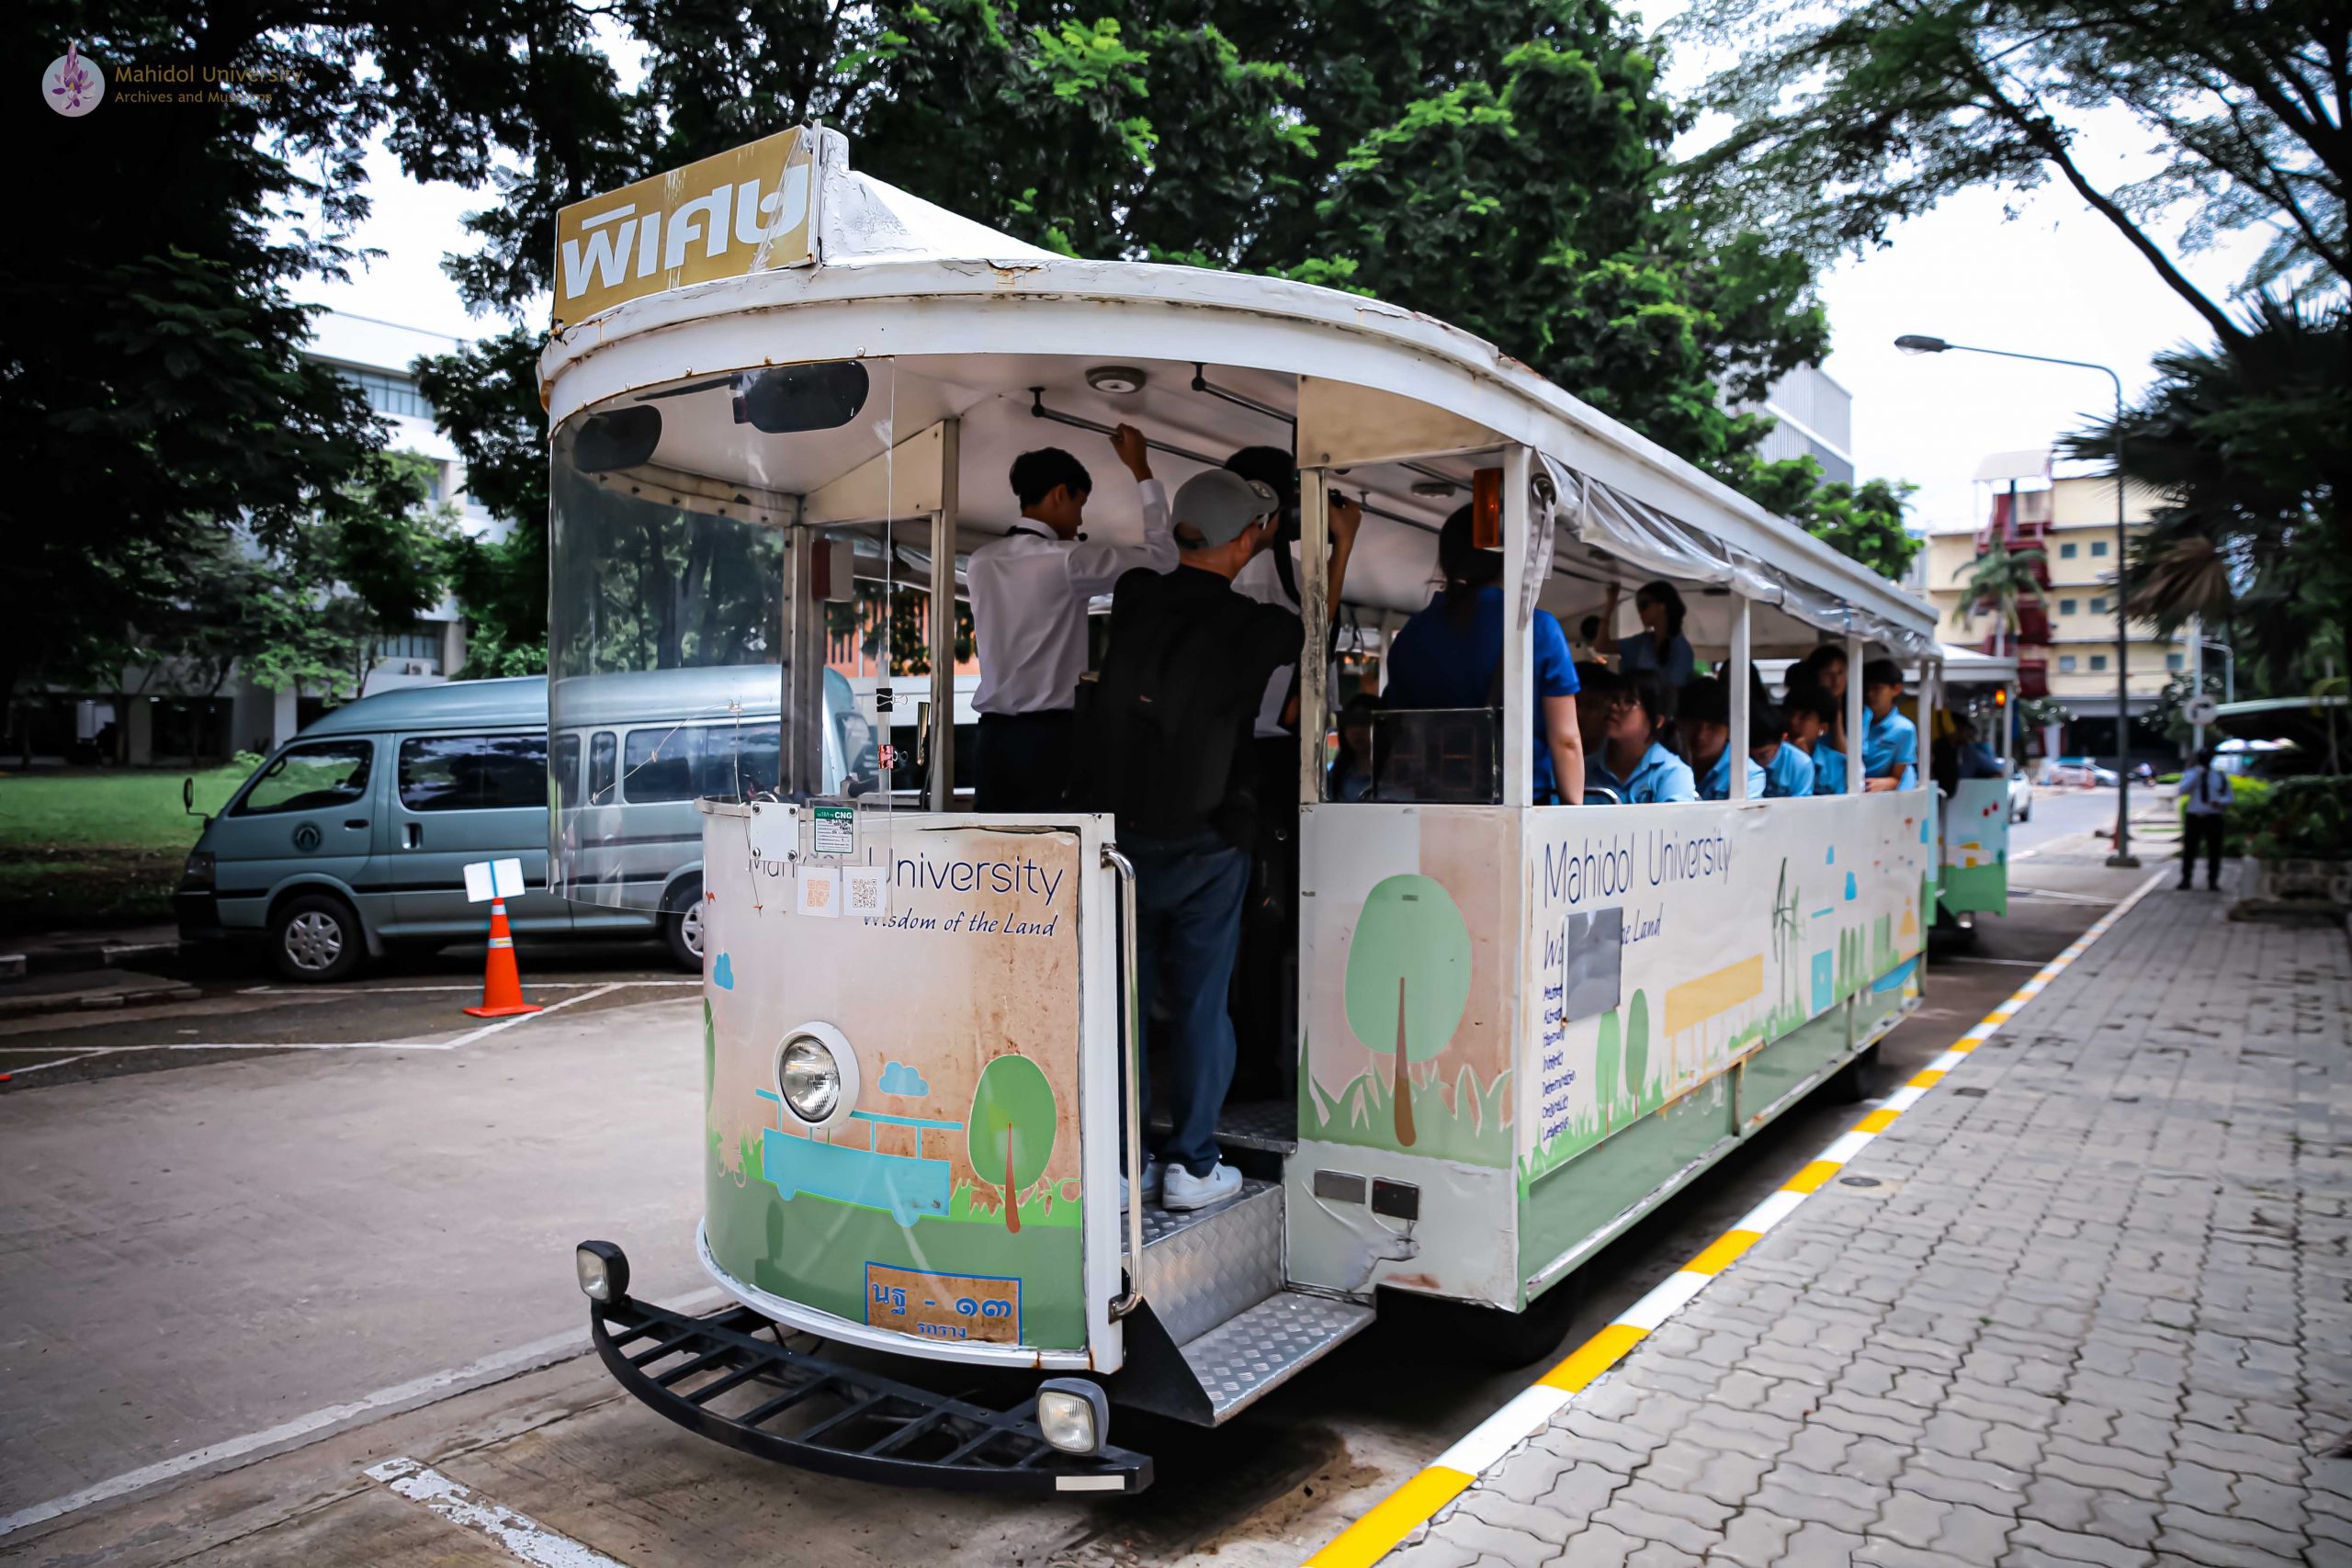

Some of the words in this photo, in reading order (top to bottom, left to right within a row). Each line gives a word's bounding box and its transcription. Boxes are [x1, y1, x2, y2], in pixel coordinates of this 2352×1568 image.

[834, 811, 853, 819] CNG
[869, 846, 1064, 907] University
[1544, 831, 1635, 909] Mahidol
[1649, 827, 1733, 886] University
[944, 910, 965, 932] of
[968, 910, 999, 932] the
[1002, 911, 1058, 937] Land
[1633, 902, 1664, 942] Land
[955, 1297, 1013, 1318] ๑๓
